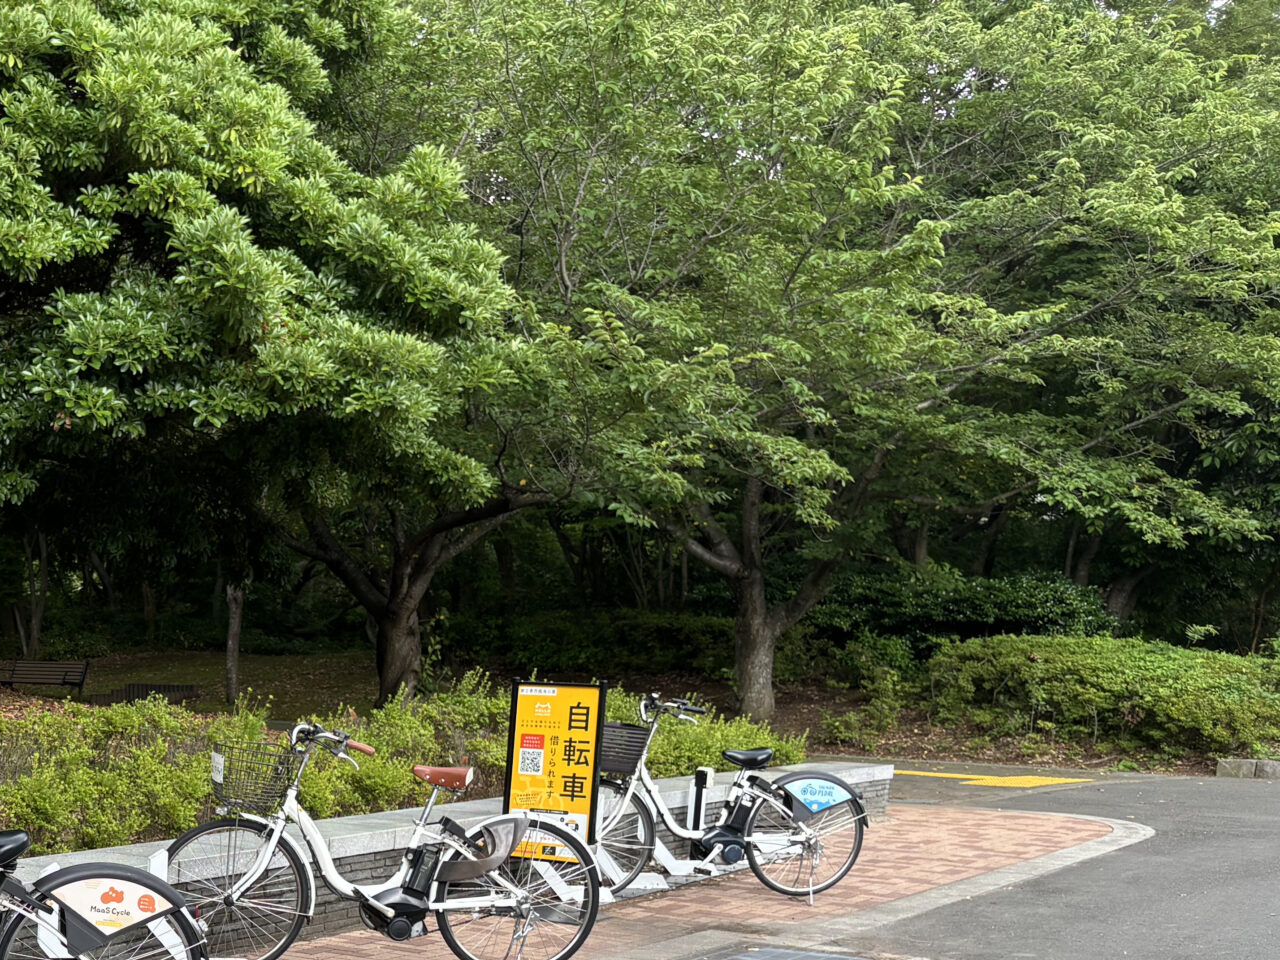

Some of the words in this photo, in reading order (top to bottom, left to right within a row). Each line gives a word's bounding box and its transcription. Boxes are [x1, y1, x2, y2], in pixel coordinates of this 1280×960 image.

[546, 735, 560, 799] 借りられます
[559, 702, 590, 802] 自転車
[90, 905, 110, 914] MaaS
[111, 907, 131, 917] Cycle
